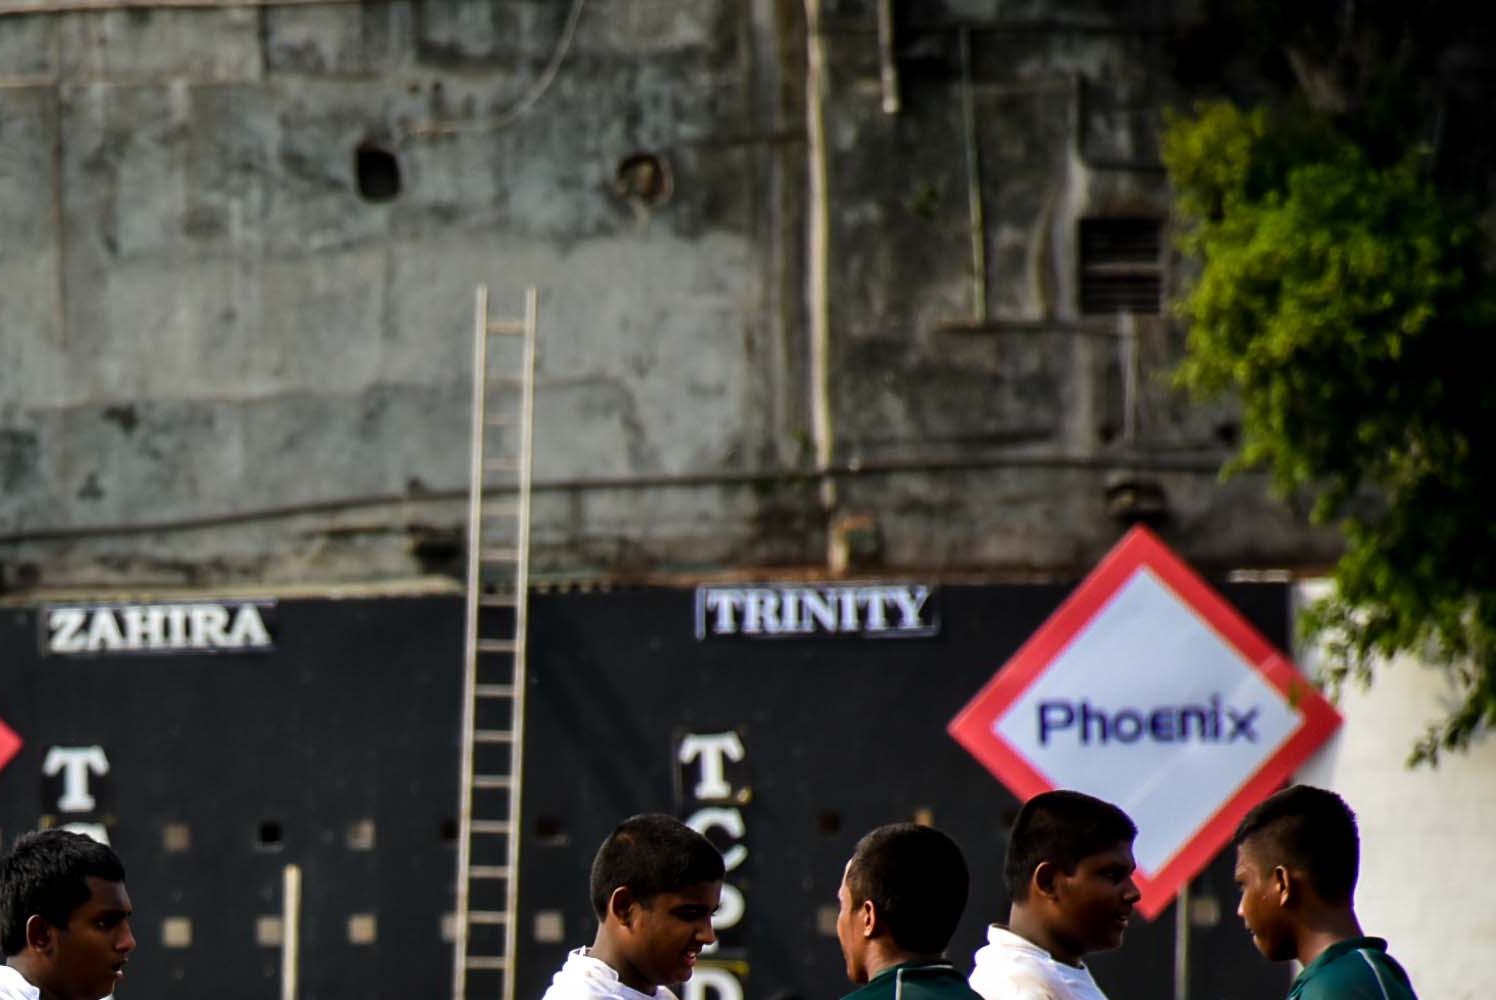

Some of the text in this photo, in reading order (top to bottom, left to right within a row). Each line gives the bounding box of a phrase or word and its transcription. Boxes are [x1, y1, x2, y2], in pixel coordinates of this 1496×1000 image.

[48, 603, 272, 653] ZAHIRA
[706, 586, 930, 635] TRINITY
[1037, 691, 1262, 748] Phoenix
